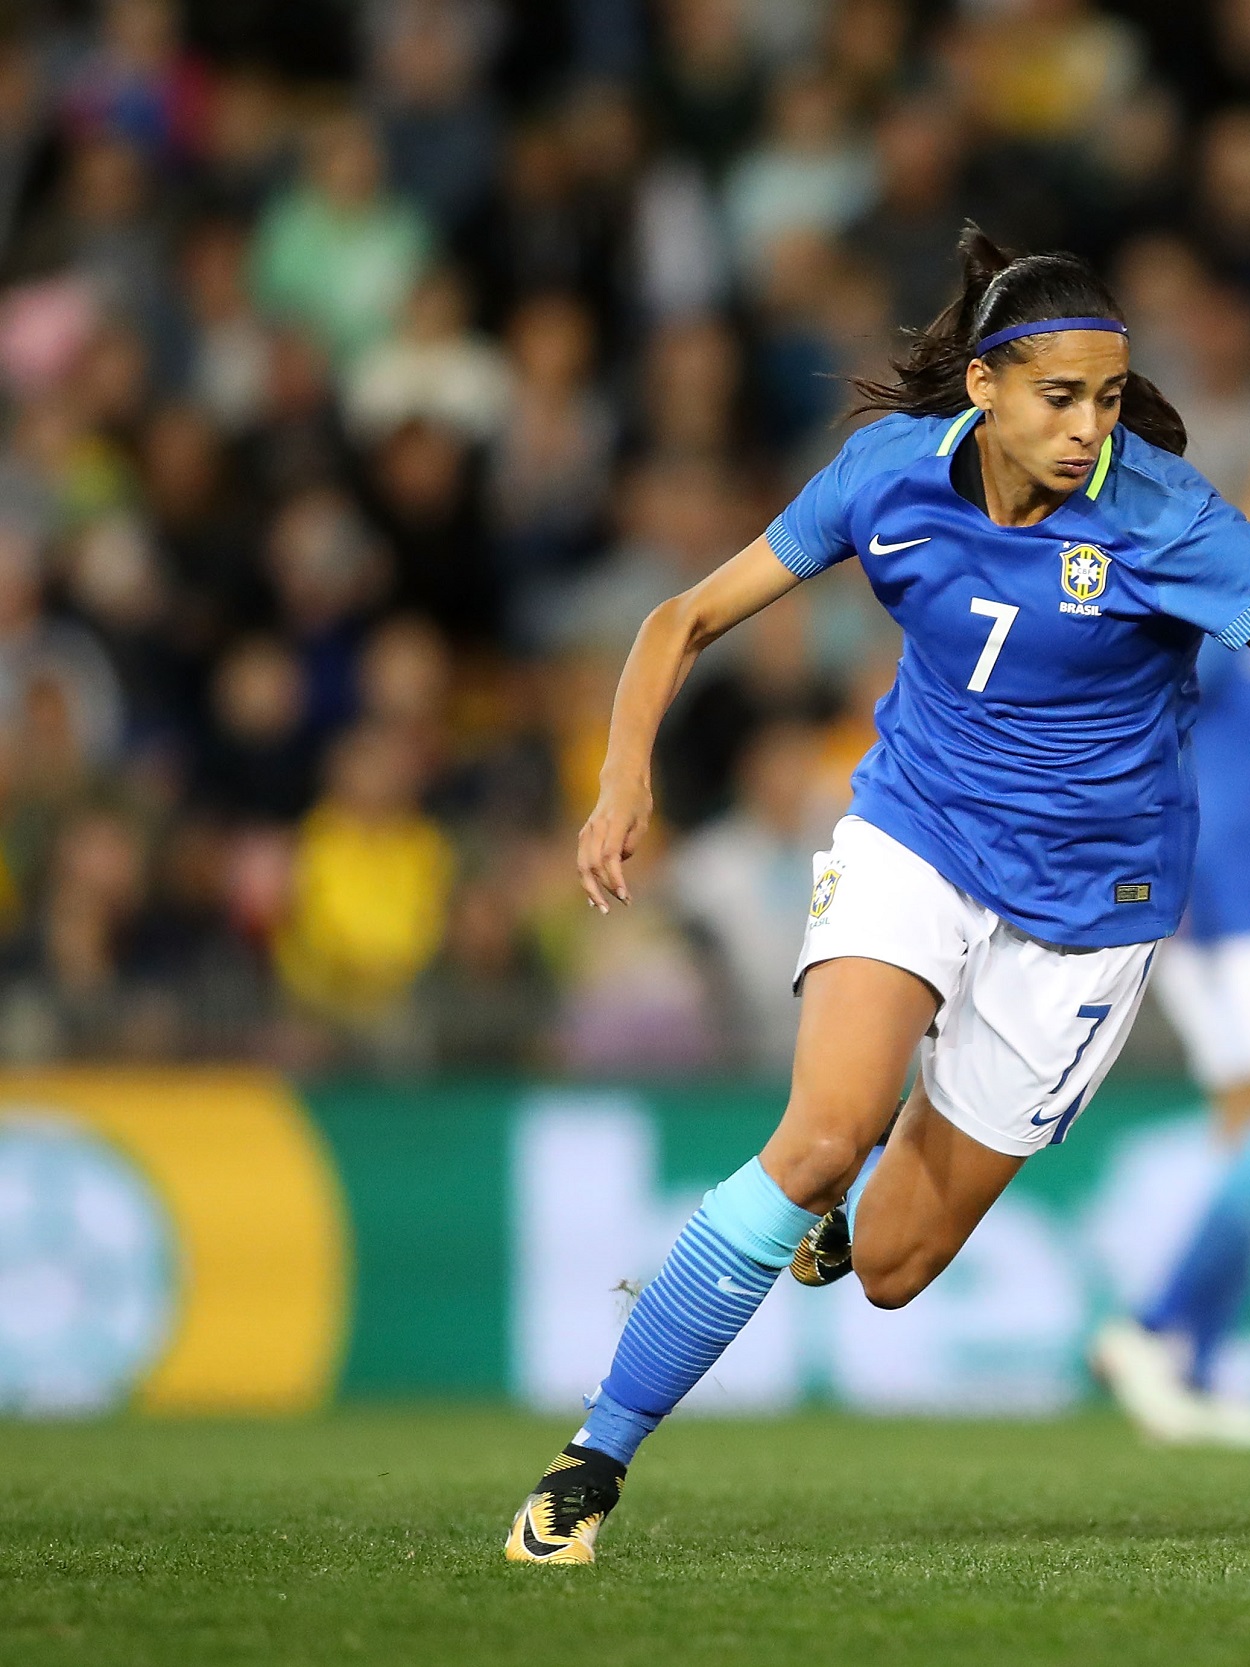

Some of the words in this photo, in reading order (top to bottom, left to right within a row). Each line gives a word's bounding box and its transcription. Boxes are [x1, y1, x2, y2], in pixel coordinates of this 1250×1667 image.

[967, 597, 1020, 693] 7
[1060, 602, 1102, 616] BRASIL
[1046, 1004, 1113, 1095] 7
